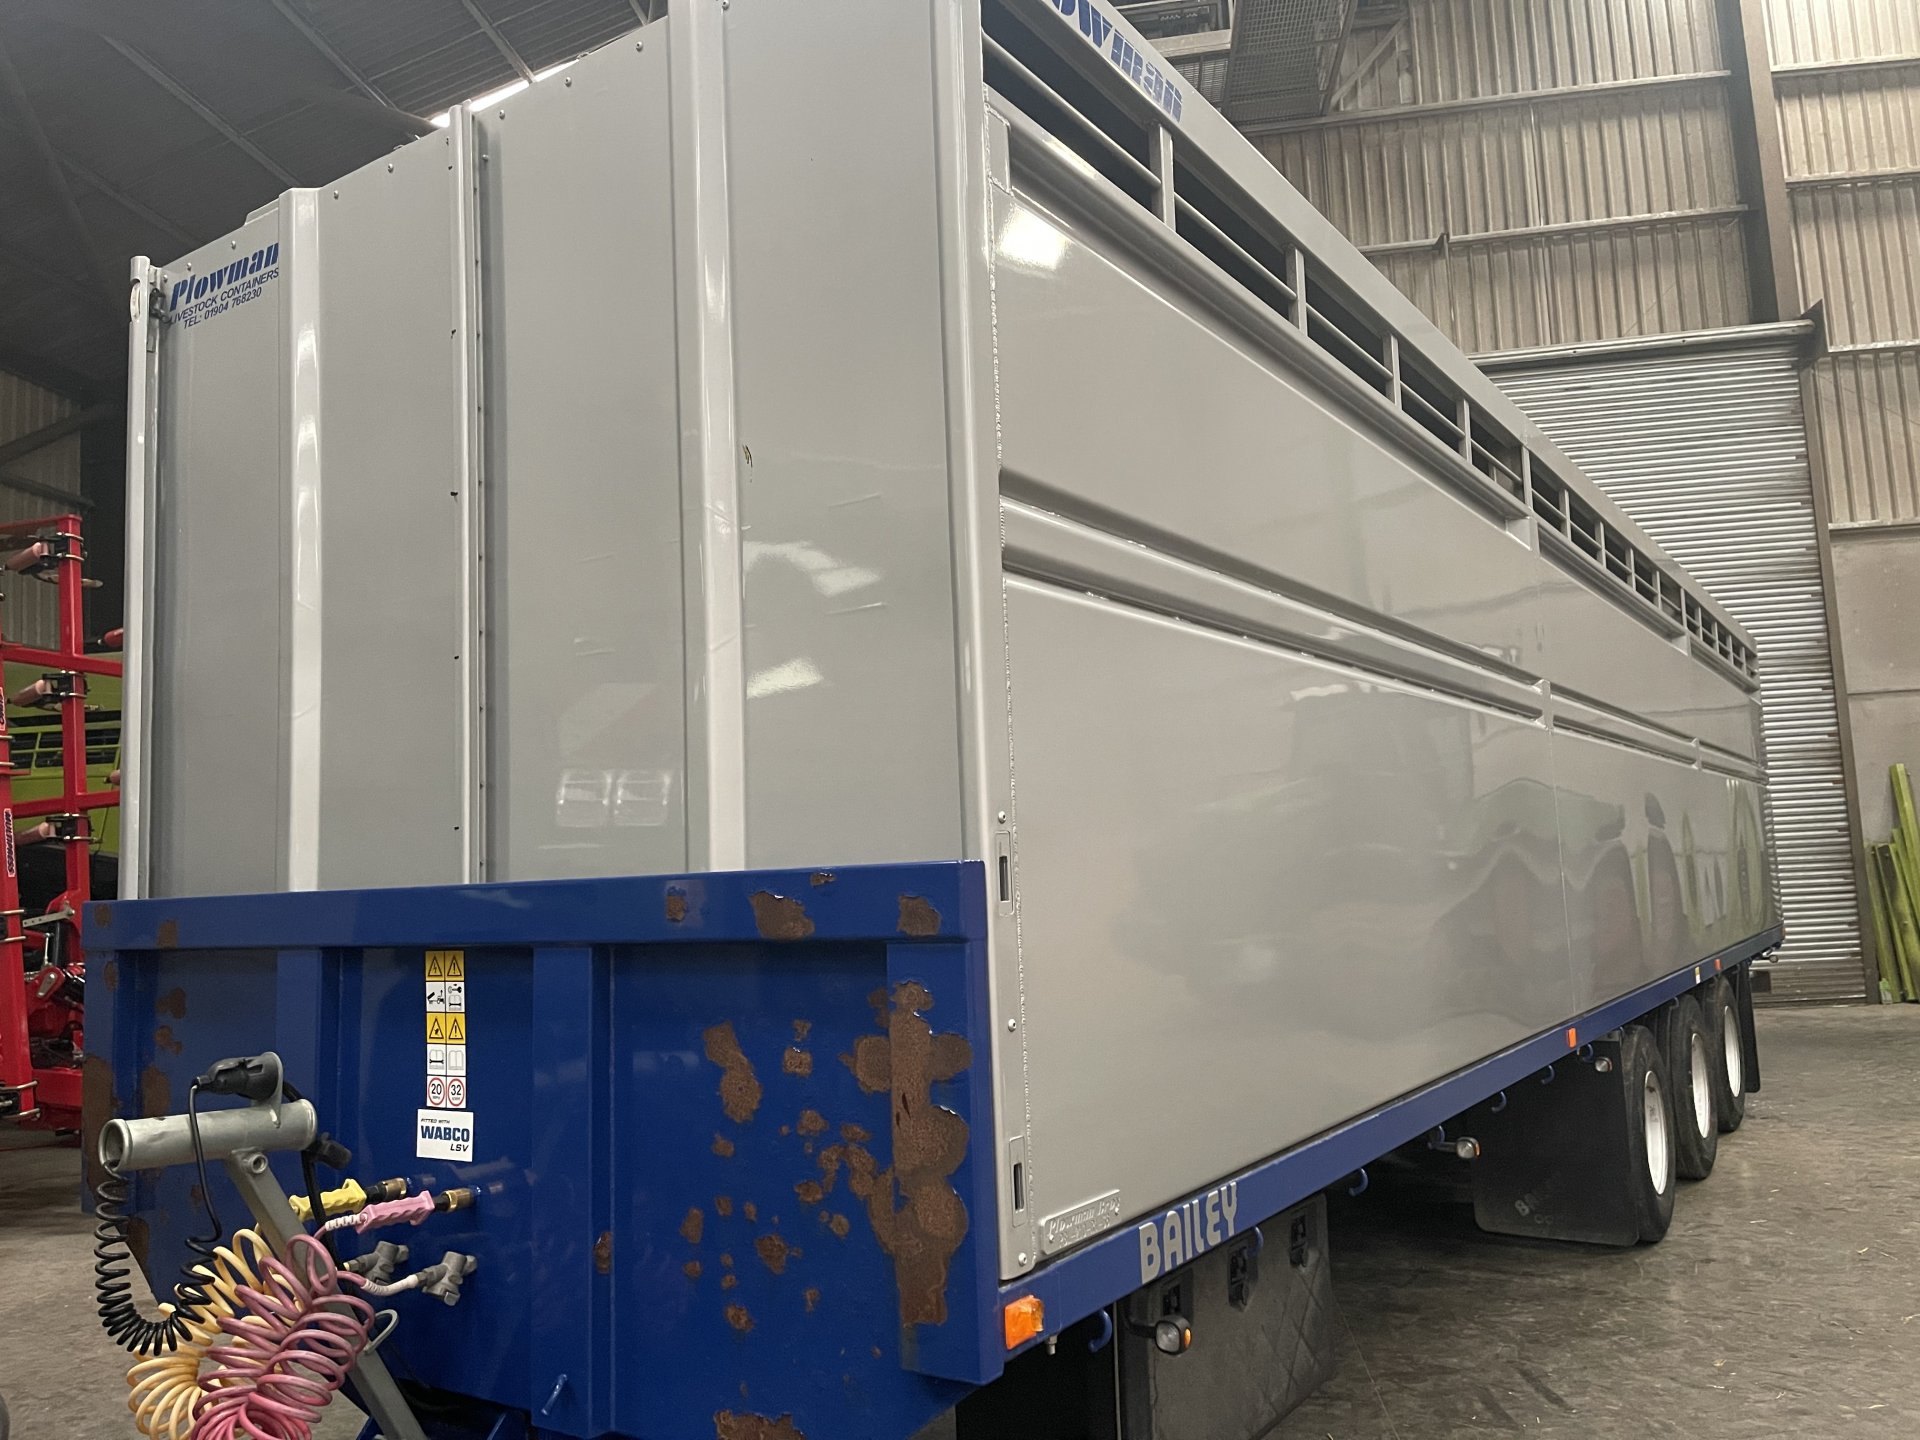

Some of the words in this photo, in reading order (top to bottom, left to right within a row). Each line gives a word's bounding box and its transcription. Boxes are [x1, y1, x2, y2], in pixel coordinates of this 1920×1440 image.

[170, 243, 279, 312] Plowman
[170, 295, 218, 325] LIVESTOCK
[220, 267, 279, 301] CONTAINERS
[204, 303, 229, 320] 01904
[231, 287, 262, 308] 768230
[431, 1083, 442, 1095] 20
[451, 1084, 461, 1096] 32
[421, 1125, 470, 1142] WABCO
[450, 1143, 469, 1152] LSV
[1139, 1182, 1237, 1285] BAILEY
